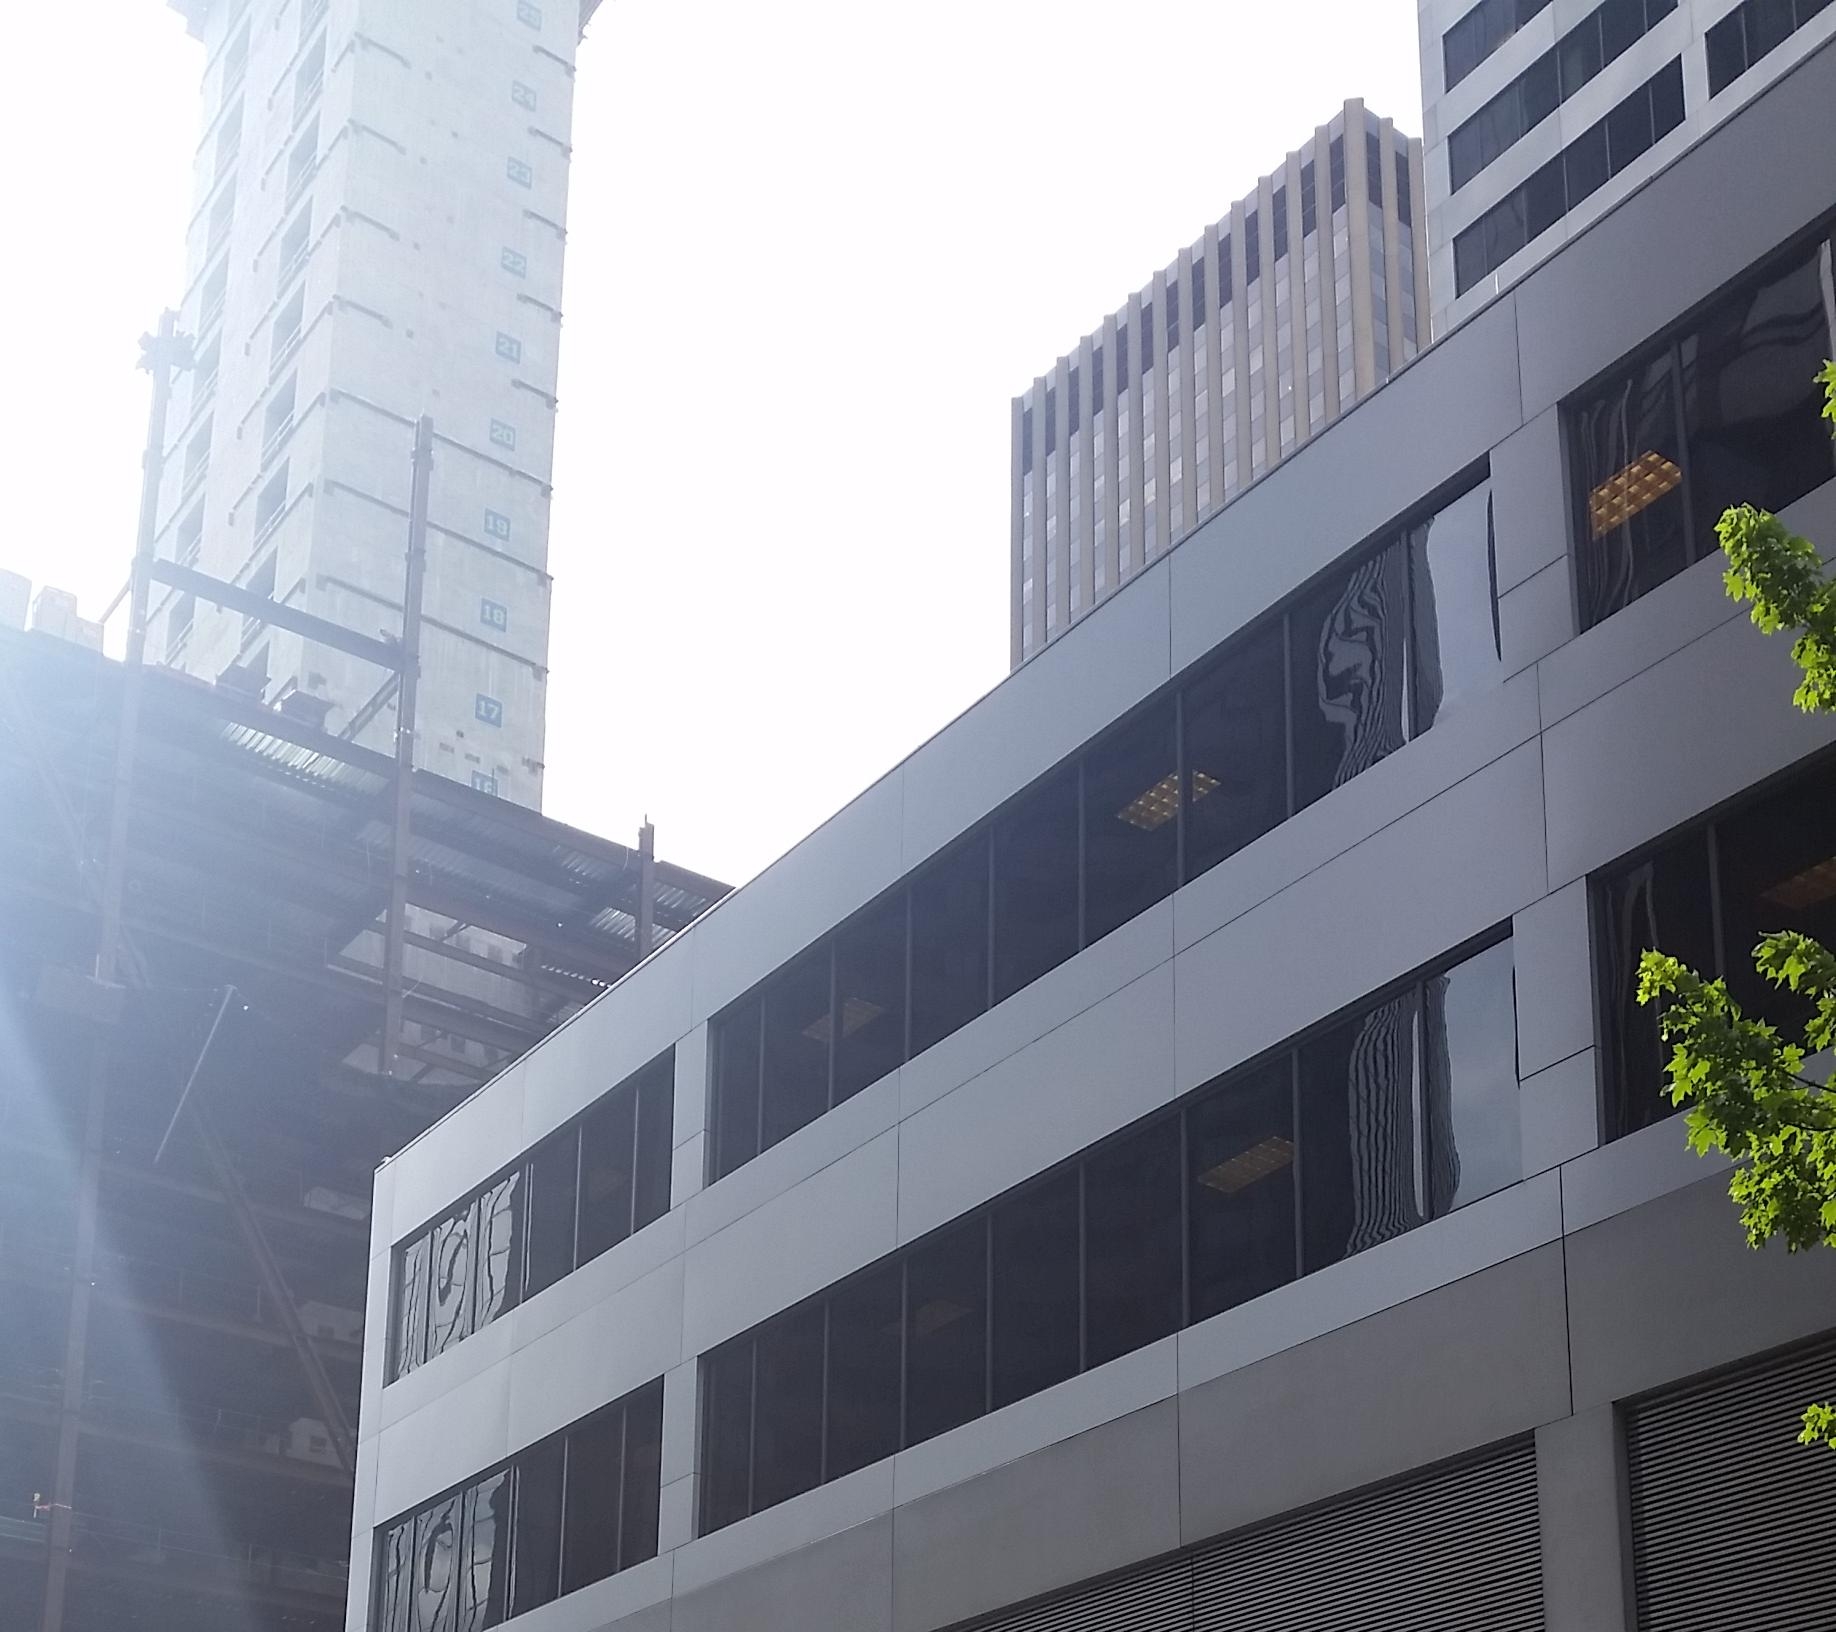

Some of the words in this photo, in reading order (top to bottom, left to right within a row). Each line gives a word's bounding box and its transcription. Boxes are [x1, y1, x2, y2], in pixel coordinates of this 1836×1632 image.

[499, 337, 518, 358] 21
[492, 423, 514, 444] 20
[487, 514, 507, 535] 19
[484, 604, 505, 625] 18
[479, 700, 499, 719] 17
